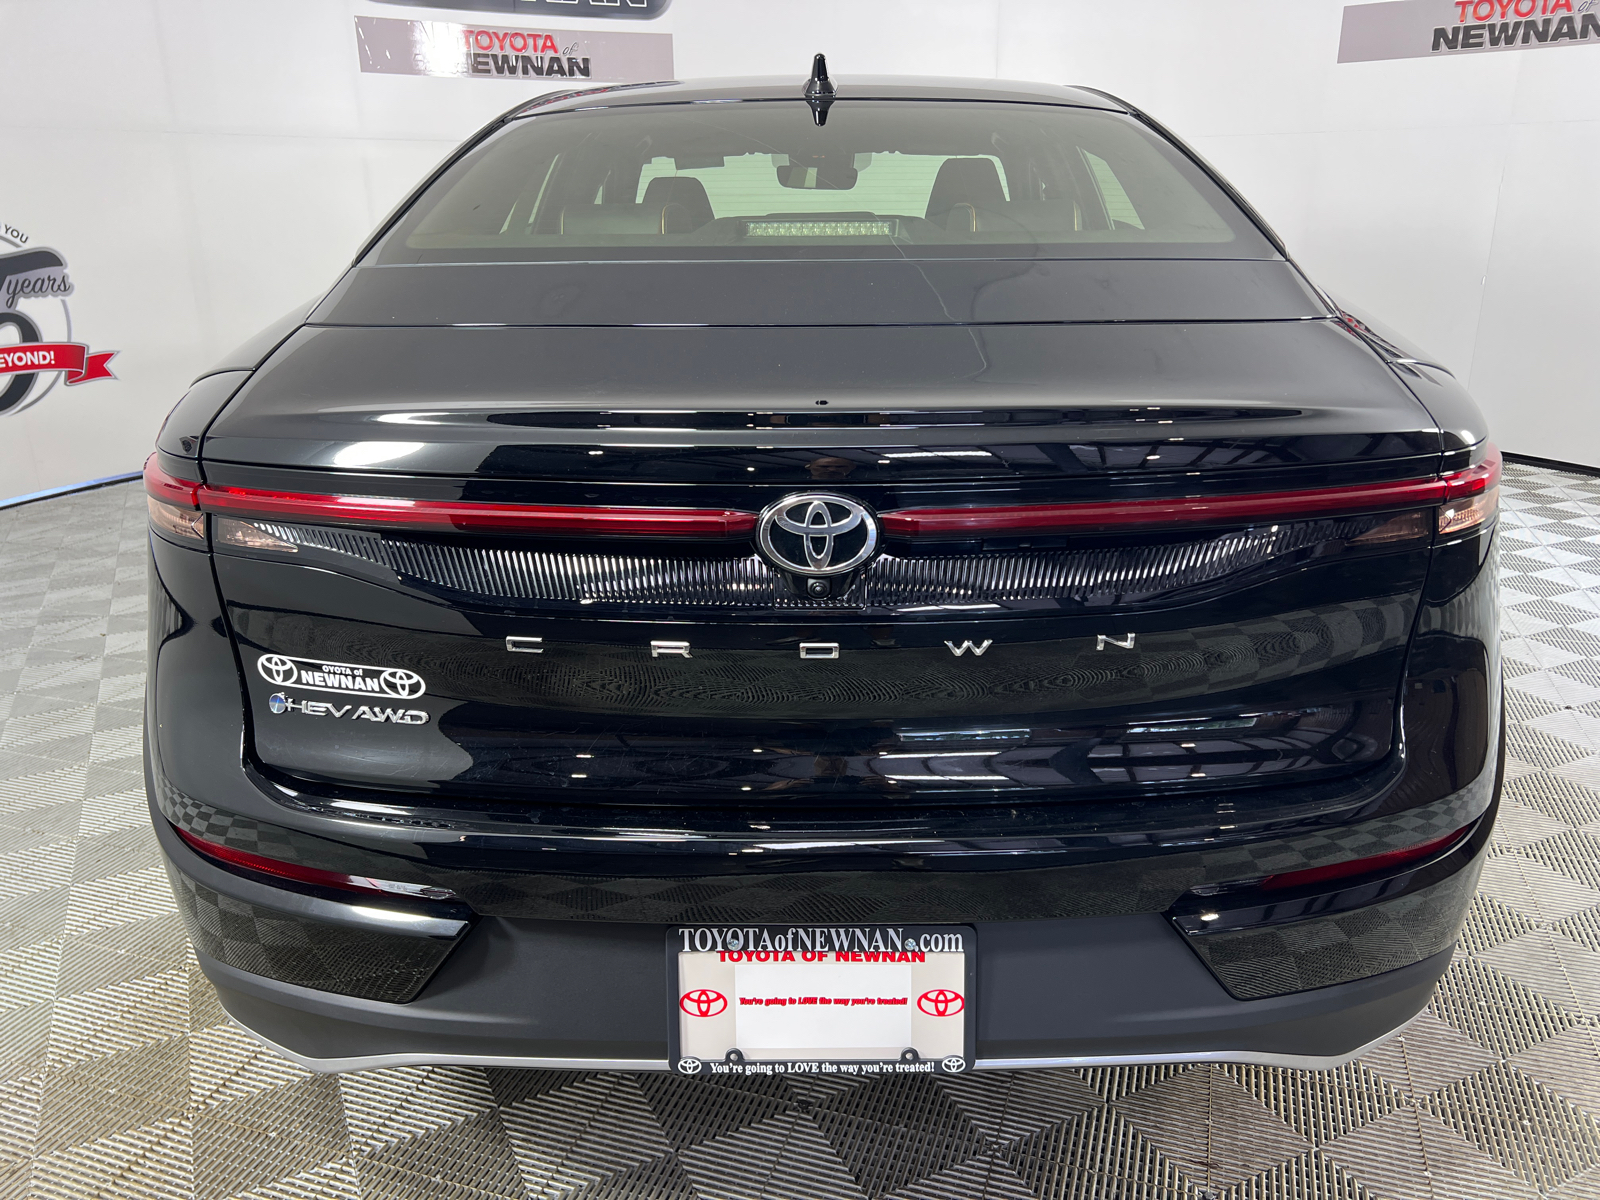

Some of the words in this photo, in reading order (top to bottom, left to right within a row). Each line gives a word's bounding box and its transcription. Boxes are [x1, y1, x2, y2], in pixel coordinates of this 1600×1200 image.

[462, 29, 559, 54] TOYOTA
[563, 42, 579, 56] of
[468, 52, 590, 77] EWNAN
[4, 224, 29, 244] YOU
[6, 274, 71, 309] years
[506, 633, 1136, 658] CROWN
[300, 670, 380, 692] NEWNAN
[353, 668, 363, 676] of
[352, 705, 431, 725] AWD
[716, 950, 796, 962] TOYOTA
[801, 950, 829, 962] OF
[835, 950, 926, 962] NEWNAN
[764, 997, 787, 1007] going
[788, 997, 797, 1005] to
[798, 996, 818, 1005] LOVE
[710, 1062, 743, 1074] You're
[745, 1062, 773, 1075] going
[775, 1063, 785, 1073] to
[787, 1062, 819, 1073] LOVE
[821, 1062, 838, 1073] the
[840, 1064, 859, 1075] way
[861, 1062, 894, 1075] you're
[895, 1062, 935, 1073] treated!
